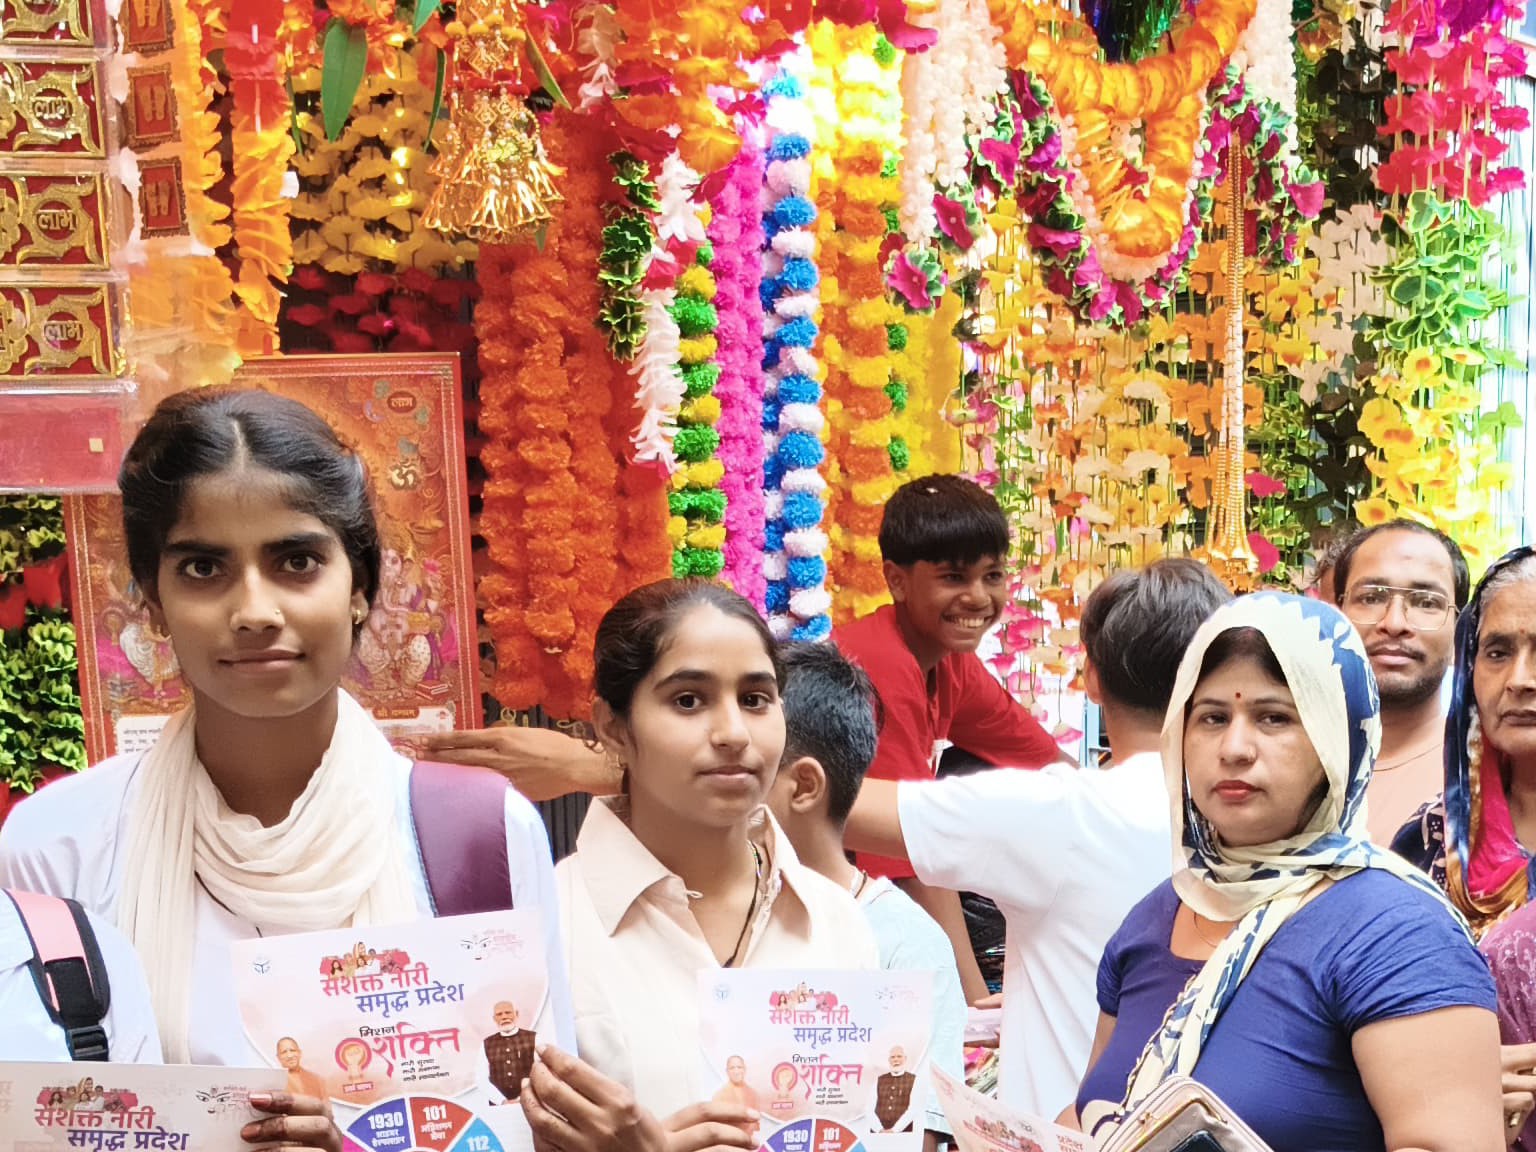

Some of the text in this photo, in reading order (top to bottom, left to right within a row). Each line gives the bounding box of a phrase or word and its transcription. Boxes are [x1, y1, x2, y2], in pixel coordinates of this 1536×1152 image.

[37, 208, 78, 232] लाभ
[45, 319, 84, 341] लाभ
[320, 962, 429, 996] सशक्त नारी
[355, 980, 465, 1018] समृद्ध प्रदेश
[769, 1004, 849, 1025] सशक्त नारी
[359, 1025, 396, 1037] मिशन
[793, 1021, 872, 1049] समृद्ध प्रदेश
[372, 1021, 461, 1079] शक्ति
[799, 1053, 863, 1100] शक्ति
[34, 1105, 156, 1129] सशक्त नारी
[367, 1112, 404, 1129] 1930
[422, 1105, 447, 1121] 101
[134, 1126, 190, 1151] प्रदेश
[466, 1135, 490, 1151] 112
[782, 1130, 809, 1144] 1930
[823, 1127, 840, 1141] 101
